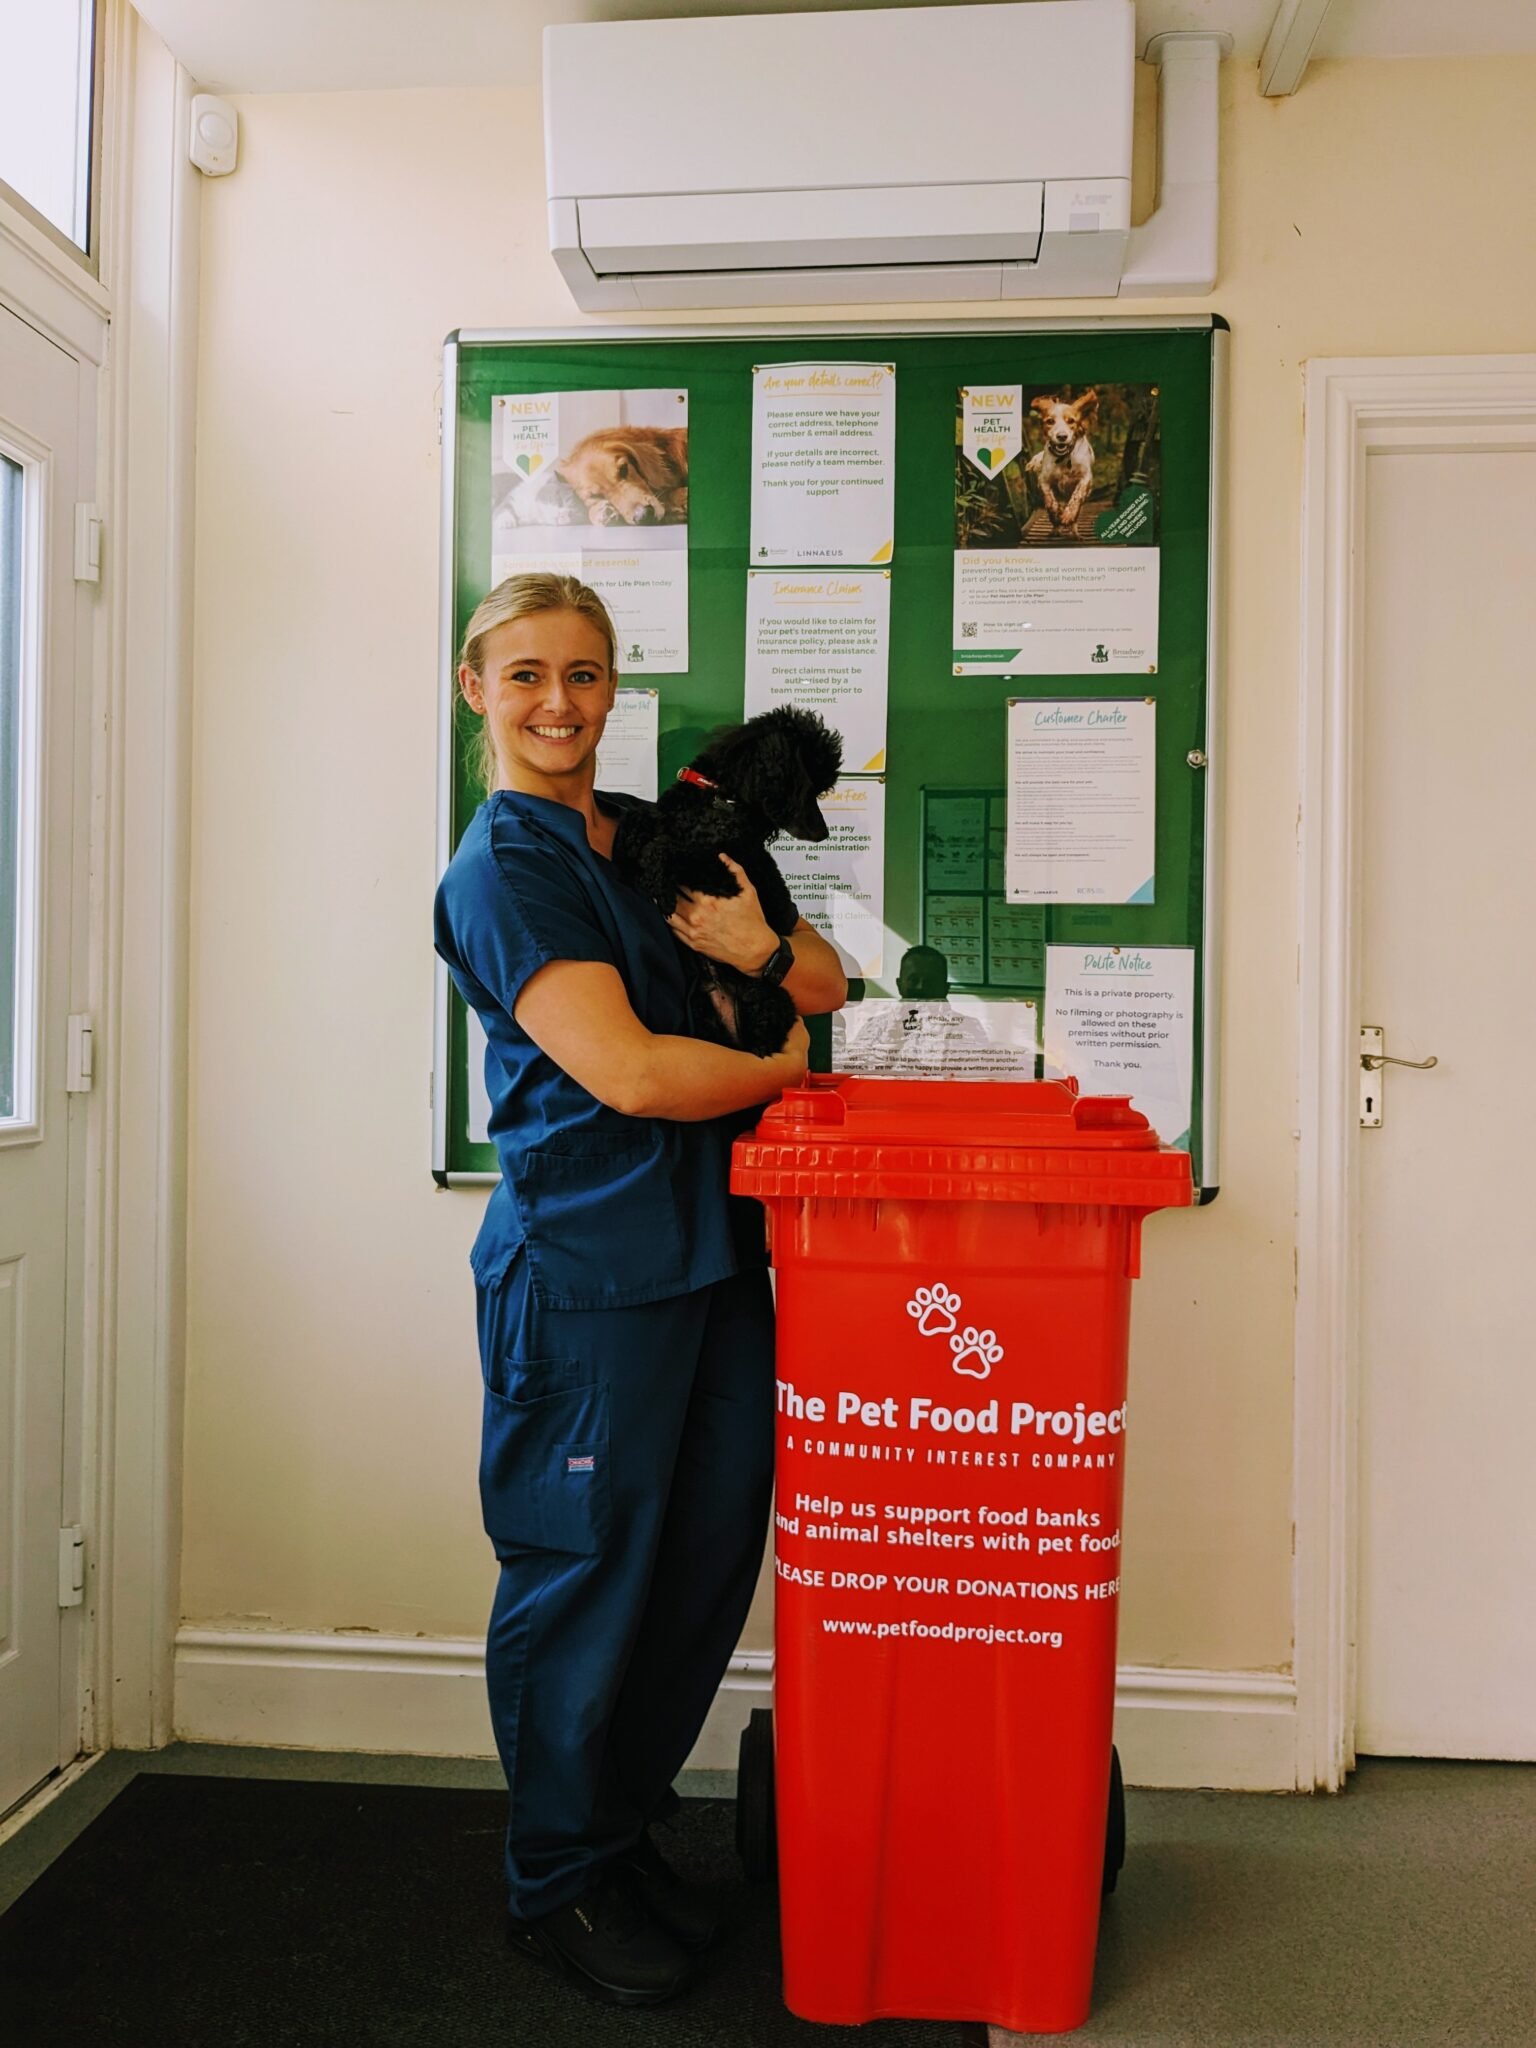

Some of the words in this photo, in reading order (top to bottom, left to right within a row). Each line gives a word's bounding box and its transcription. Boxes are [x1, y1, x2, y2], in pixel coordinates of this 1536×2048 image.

[845, 370, 883, 390] correct?
[971, 394, 1014, 408] NEW
[511, 402, 551, 415] NEW
[836, 420, 878, 428] telephone
[984, 418, 1001, 426] PET
[513, 432, 548, 440] HEALTH
[762, 461, 788, 469] please
[790, 459, 814, 467] notify
[1119, 503, 1136, 520] ROUND
[1119, 510, 1145, 535] TREATMENT
[1125, 515, 1148, 538] INCLUDED
[1107, 528, 1118, 539] TICK
[1117, 519, 1128, 530] AND
[963, 557, 980, 565] Did
[962, 567, 1003, 575] preventing
[1108, 565, 1146, 574] important
[1007, 575, 1025, 583] pet's
[773, 582, 823, 595] Insurance
[827, 581, 862, 595] Claims
[779, 628, 799, 636] pet's
[829, 638, 855, 646] please
[832, 677, 842, 685] by
[832, 687, 851, 695] prior
[1035, 707, 1084, 725] Customer
[1088, 707, 1128, 725] Charter
[840, 835, 871, 843] process
[788, 884, 801, 892] per
[1084, 953, 1116, 971] Polite
[1120, 952, 1152, 971] Notice
[1085, 988, 1092, 996] is
[1102, 989, 1132, 998] private
[1134, 991, 1174, 1000] property.
[1070, 1009, 1102, 1018] filming
[1116, 1011, 1174, 1020] photography
[1068, 1030, 1108, 1038] premises
[1110, 1030, 1146, 1038] without
[1110, 1041, 1161, 1049] permission.
[776, 1379, 825, 1422] The
[837, 1391, 899, 1428] Pet
[909, 1397, 999, 1434] Food
[1010, 1401, 1128, 1445] Project
[787, 1436, 794, 1450] A
[804, 1439, 915, 1463] COMMUNITY
[927, 1450, 1020, 1467] INTEREST
[1032, 1453, 1115, 1469] COMPANY
[795, 1493, 843, 1517] Help
[851, 1501, 876, 1517] us
[884, 1503, 971, 1525] support
[978, 1506, 1028, 1526] food
[1036, 1508, 1101, 1527] banks
[776, 1511, 799, 1535] and
[805, 1522, 879, 1543] animal
[887, 1526, 974, 1549] shelters
[983, 1531, 1030, 1551] with
[1038, 1535, 1072, 1555] pet
[1080, 1529, 1121, 1552] food.
[831, 1571, 887, 1590] DROP
[894, 1576, 949, 1595] YOUR
[956, 1579, 1078, 1600] DONATIONS
[1085, 1576, 1121, 1600] HERE
[822, 1618, 1063, 1648] www.petfoodproject.org
